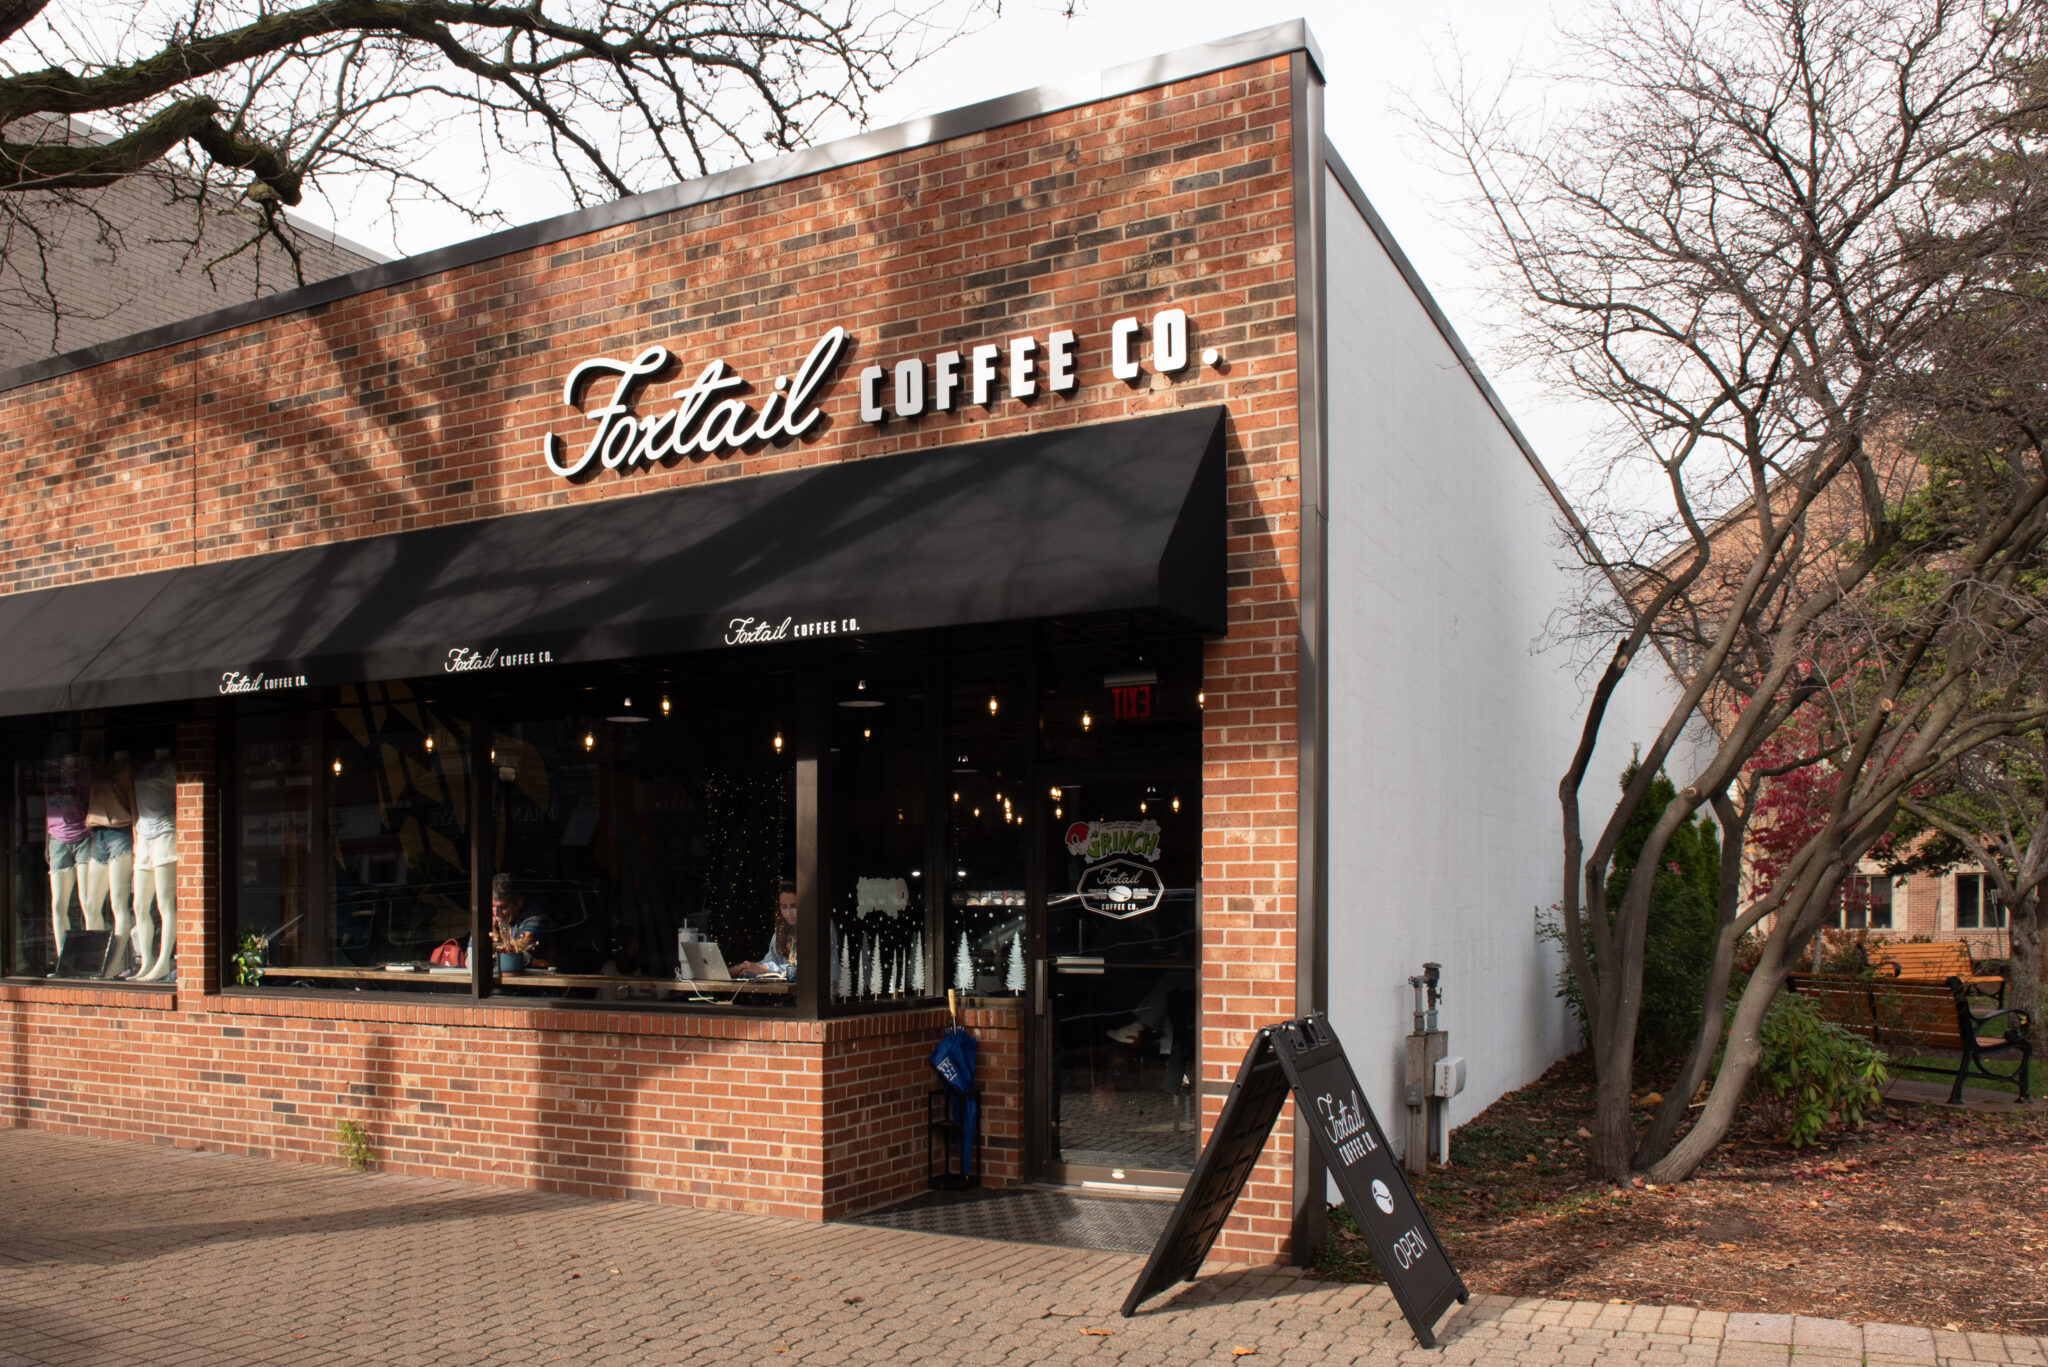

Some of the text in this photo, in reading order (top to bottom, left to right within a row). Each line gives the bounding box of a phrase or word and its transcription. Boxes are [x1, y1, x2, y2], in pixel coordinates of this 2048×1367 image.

[543, 307, 1220, 477] Foxtail COFFEE CO.
[724, 616, 861, 645] Foxtail COFFEE CO.
[444, 647, 554, 673] Foxtail COFFEE CO.
[219, 671, 308, 695] Foxtail COFFEE CO.
[1087, 829, 1158, 858] GRINCH
[1096, 867, 1144, 885] Foxtail
[1101, 903, 1139, 911] COFFEE CO.
[1317, 1089, 1366, 1144] Foxtail
[1339, 1132, 1378, 1166] COFFEE CO.
[1393, 1225, 1428, 1270] OPEN
